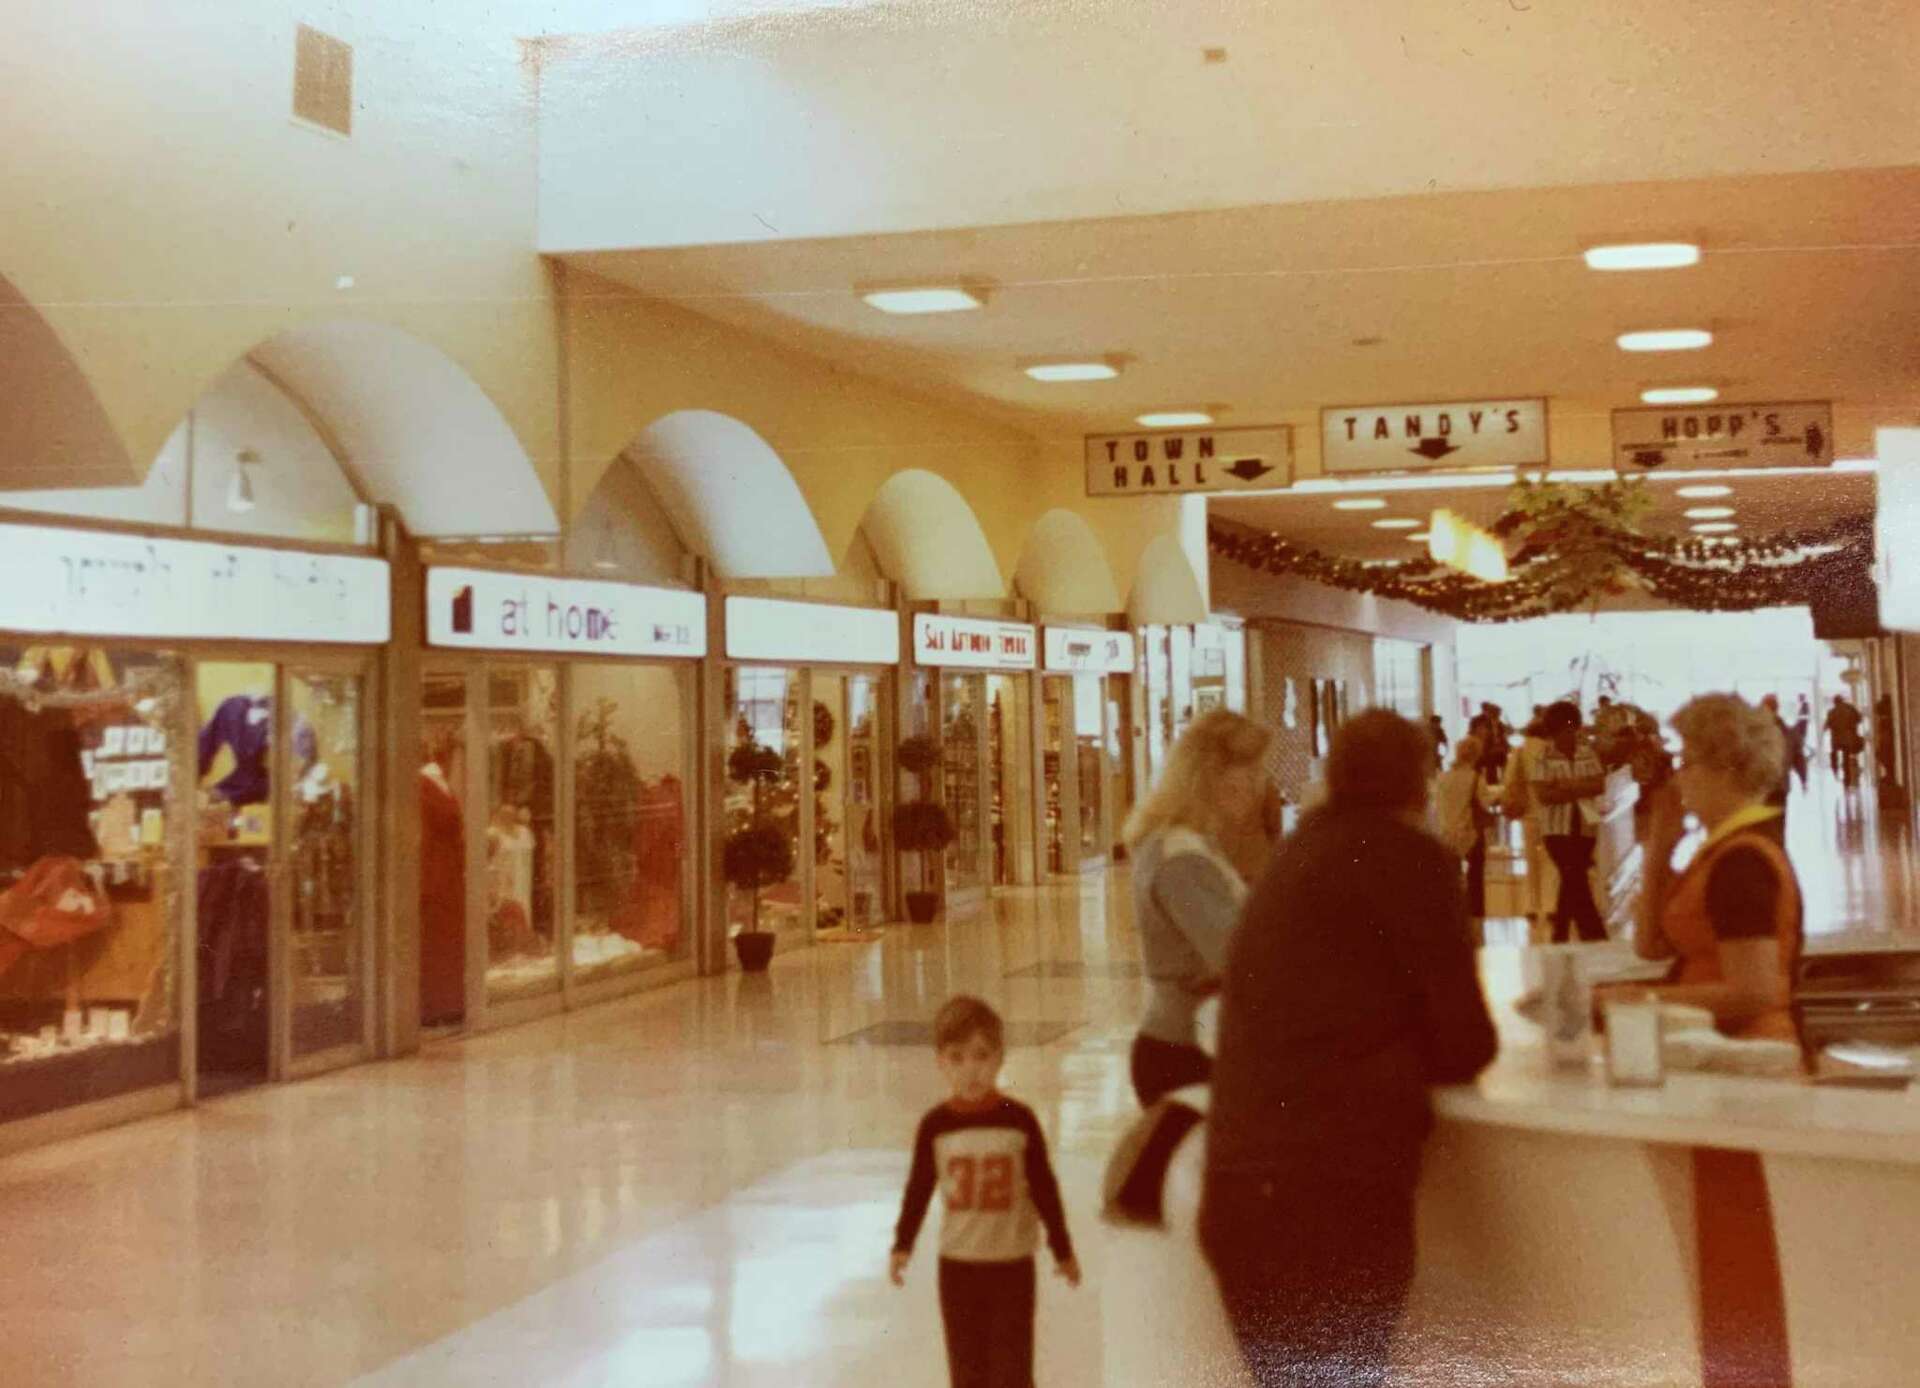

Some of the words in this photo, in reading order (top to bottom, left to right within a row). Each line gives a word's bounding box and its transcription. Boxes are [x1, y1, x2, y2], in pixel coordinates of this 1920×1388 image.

[1344, 409, 1520, 440] TANDY'S
[1662, 410, 1781, 439] HOPP'S
[1105, 437, 1215, 462] TOWN
[1114, 463, 1206, 488] HALL
[501, 588, 529, 637] at
[547, 590, 618, 641] home
